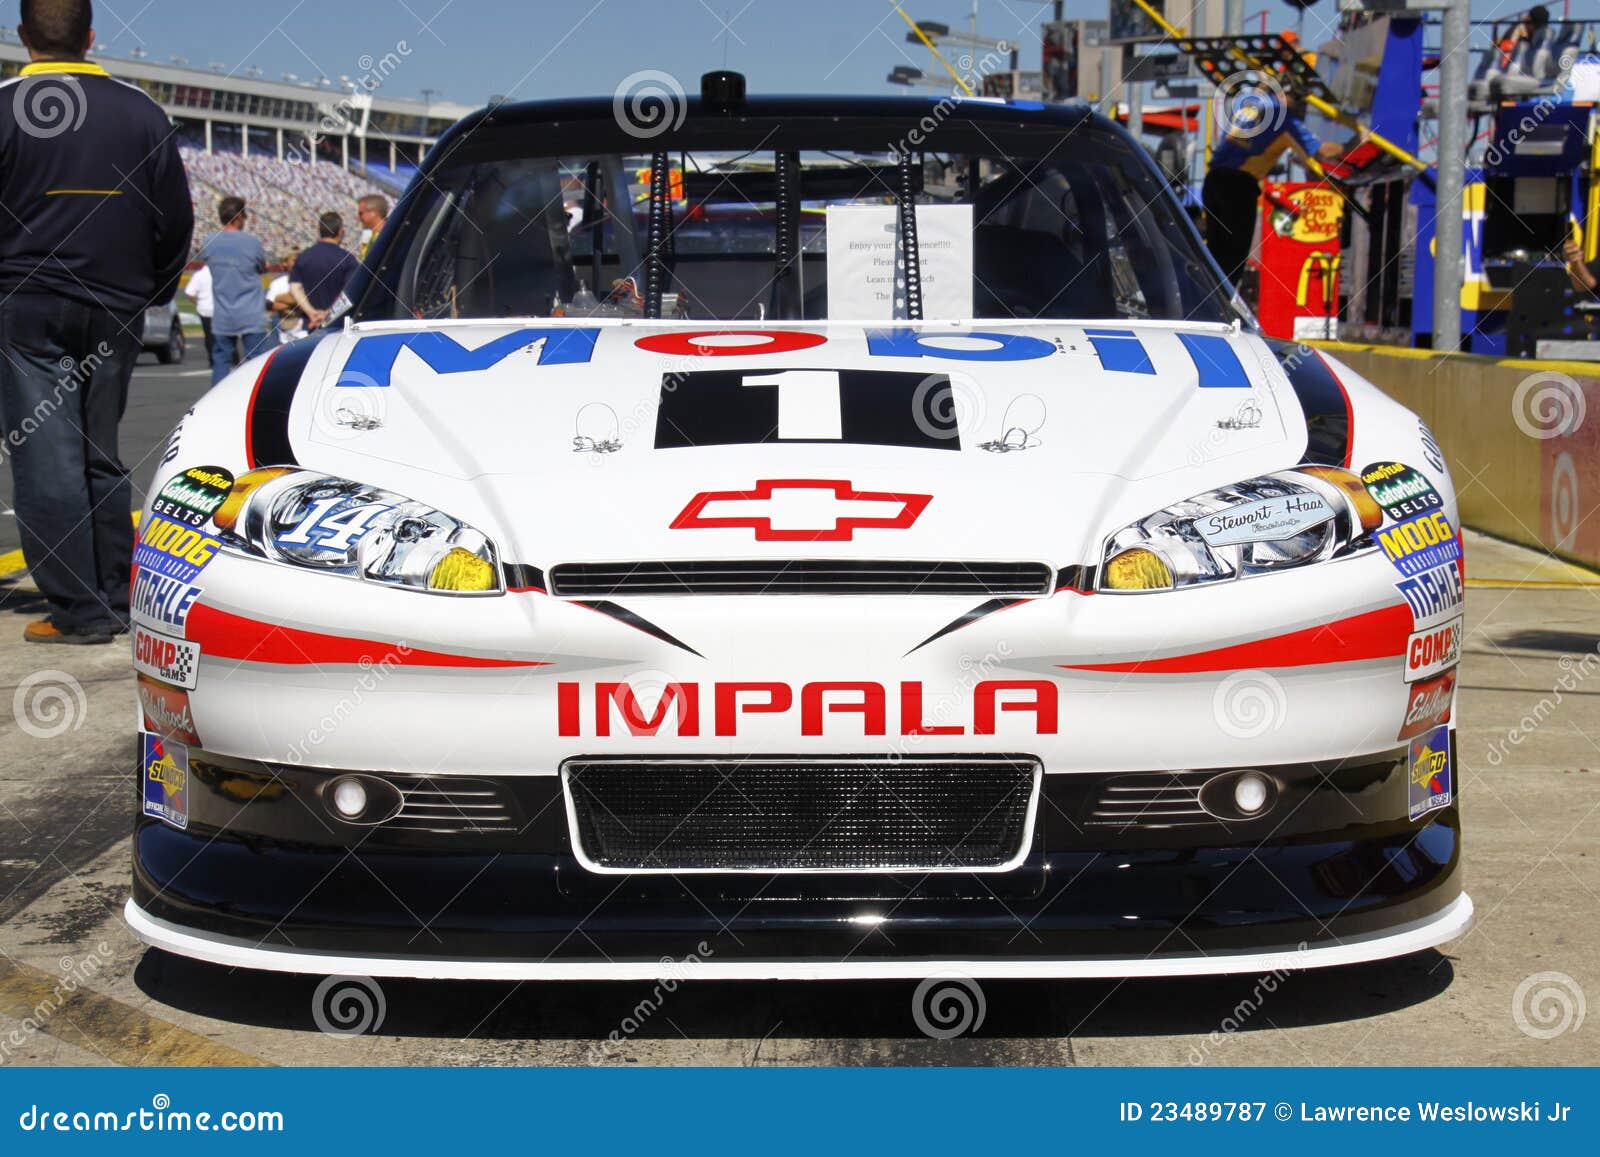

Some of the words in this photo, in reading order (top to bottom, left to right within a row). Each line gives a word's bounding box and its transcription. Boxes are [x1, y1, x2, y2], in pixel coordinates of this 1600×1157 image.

[336, 327, 1252, 388] Mobil
[742, 371, 842, 439] 1
[154, 499, 204, 525] BELTS
[275, 495, 396, 553] 14
[1206, 505, 1274, 536] Stewart
[1286, 498, 1324, 513] Haas
[1390, 494, 1439, 518] BELTS
[143, 517, 222, 567] MOOG
[1378, 511, 1454, 562] MOOG
[132, 568, 203, 626] MAHLE
[1395, 562, 1462, 619] MAHLE
[136, 631, 176, 669] COMP
[1410, 627, 1453, 670] COMP
[160, 666, 187, 682] CAMS
[557, 680, 1059, 737] IMPALA
